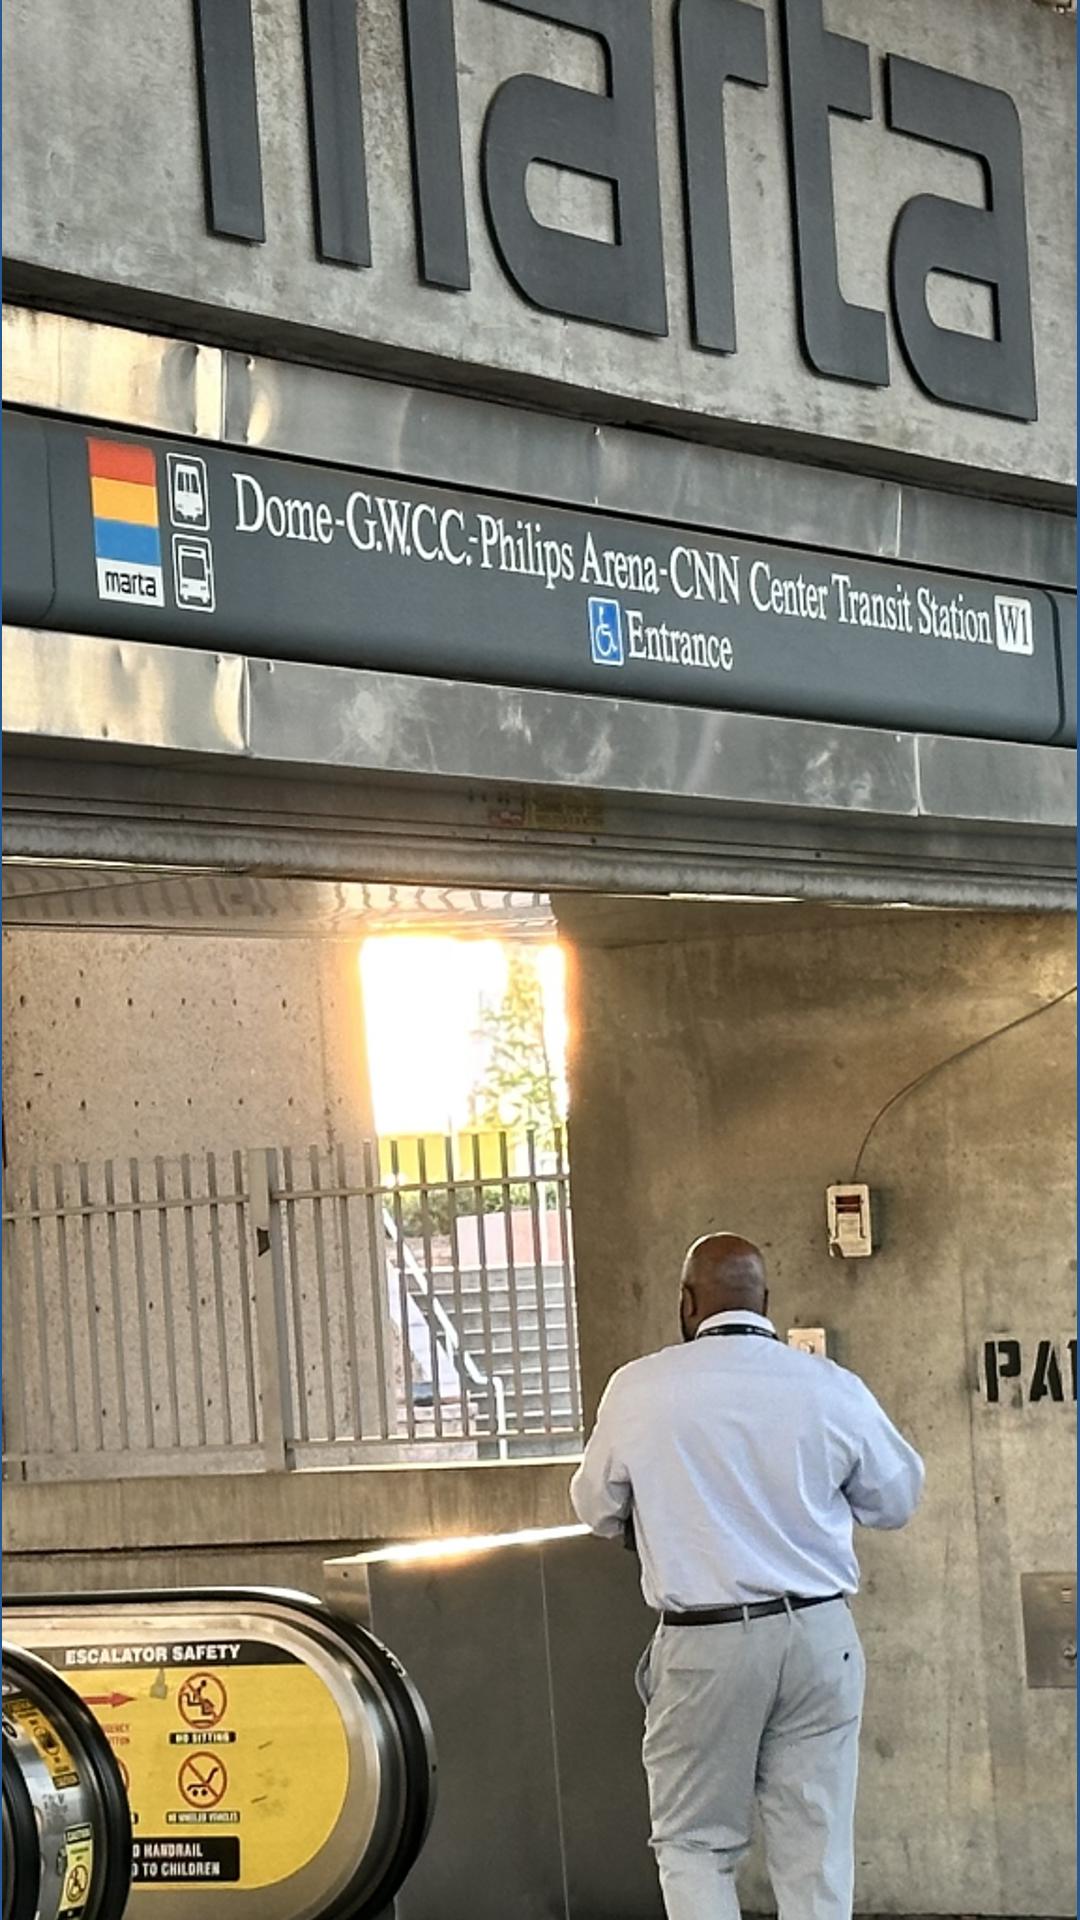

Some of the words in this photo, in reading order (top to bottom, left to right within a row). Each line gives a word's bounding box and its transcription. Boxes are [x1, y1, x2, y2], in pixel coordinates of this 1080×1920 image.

[196, 0, 1037, 421] marta
[105, 570, 157, 598] marta
[580, 531, 740, 605] Arena-CNN
[750, 561, 828, 620] Center
[831, 573, 913, 633] Transit
[917, 587, 993, 645] Station
[625, 609, 733, 671] Entrance
[65, 1646, 168, 1665] ESCALATOR
[172, 1643, 241, 1661] SAFETY
[143, 1843, 204, 1858] HANDRAIL
[142, 1862, 158, 1877] TO
[160, 1861, 221, 1876] CHILDREN
